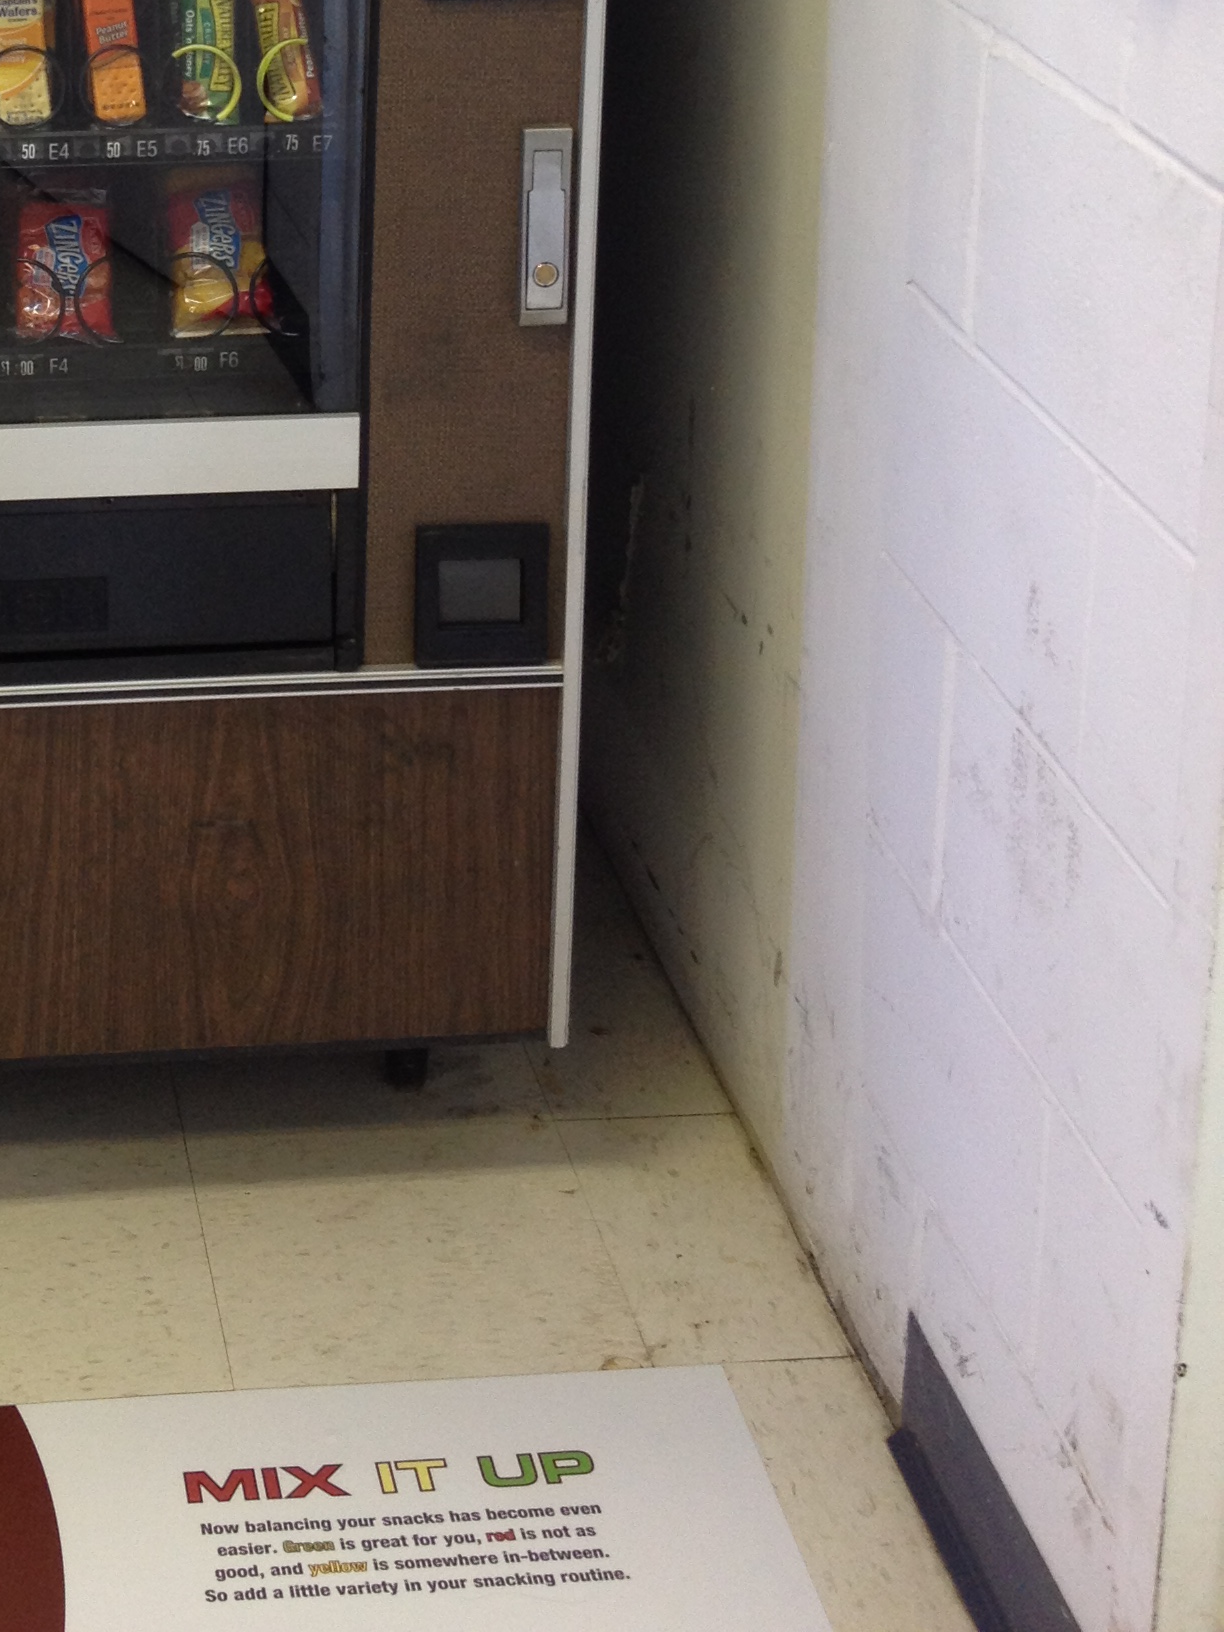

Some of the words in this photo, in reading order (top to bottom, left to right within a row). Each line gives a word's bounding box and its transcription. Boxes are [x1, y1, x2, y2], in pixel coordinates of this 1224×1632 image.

[96, 21, 128, 36] Peanut
[99, 31, 129, 45] Butter
[49, 143, 70, 161] E4
[137, 140, 158, 158] E5
[228, 137, 249, 154] E6
[313, 135, 332, 152] E7
[199, 195, 235, 269] ZINGERS
[49, 358, 69, 375] F4
[219, 352, 239, 368] F6
[183, 1463, 350, 1503] MIX
[374, 1458, 446, 1493] IT
[476, 1450, 593, 1487] UP
[199, 1522, 240, 1536] Now
[244, 1517, 333, 1534] balancing
[336, 1516, 377, 1532] your
[381, 1511, 446, 1527] snacks
[448, 1510, 482, 1523] has
[484, 1506, 556, 1521] become
[559, 1504, 603, 1517] even
[216, 1542, 278, 1557] easier.
[281, 1539, 336, 1554] Green
[338, 1537, 357, 1551] is
[360, 1534, 410, 1553] great
[411, 1533, 438, 1547] for
[442, 1533, 483, 1548] you,
[484, 1527, 517, 1543] red
[519, 1527, 538, 1541] is
[540, 1525, 572, 1540] not
[574, 1526, 597, 1538] as
[214, 1564, 265, 1583] good,
[269, 1561, 305, 1577] and
[306, 1559, 369, 1578] yellow
[371, 1557, 390, 1572] is
[393, 1553, 499, 1571] somewhere
[501, 1547, 611, 1564] in-between.
[204, 1588, 229, 1603] So
[233, 1586, 268, 1602] add
[272, 1588, 285, 1600] a
[288, 1583, 332, 1599] little
[335, 1580, 399, 1596] variety
[403, 1578, 423, 1593] in
[426, 1578, 468, 1594] your
[472, 1571, 557, 1589] snacking
[559, 1568, 632, 1584] routine.
